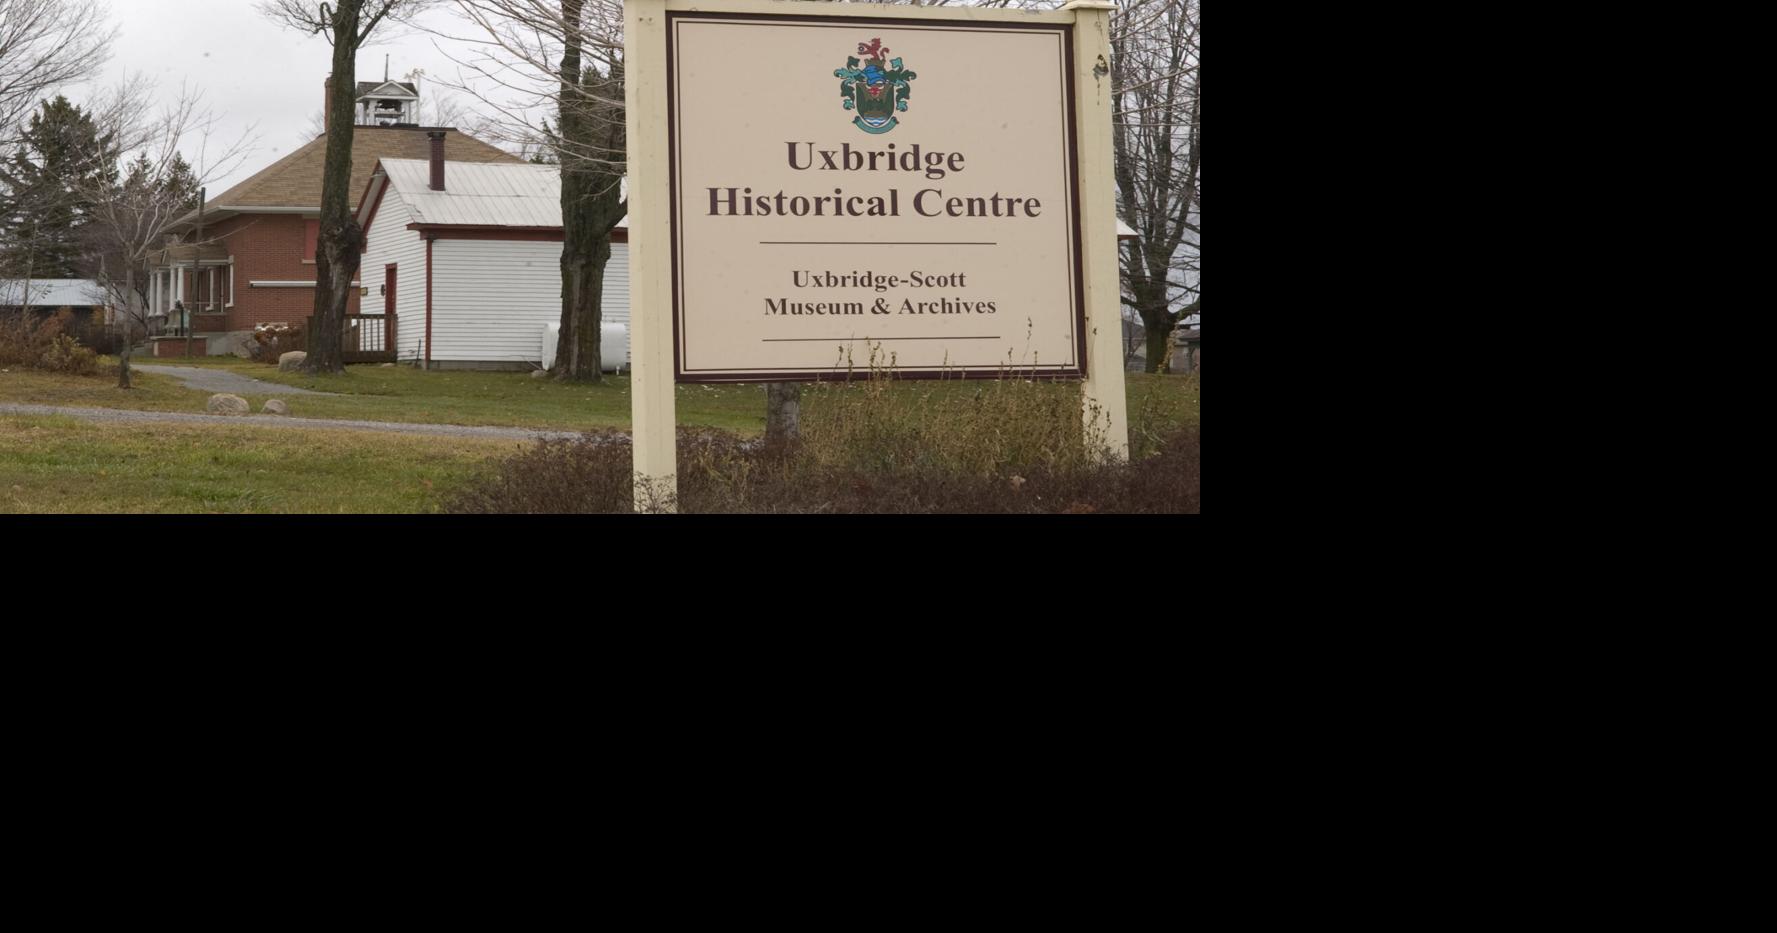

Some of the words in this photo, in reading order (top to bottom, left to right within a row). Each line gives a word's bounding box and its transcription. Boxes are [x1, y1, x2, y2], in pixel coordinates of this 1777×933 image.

[785, 141, 966, 180] Uxbridge
[705, 186, 900, 217] Historical
[912, 188, 1042, 218] Centre
[792, 269, 967, 292] Uxbridge-Scott
[763, 297, 864, 316] Museum
[870, 297, 891, 315] &
[897, 296, 997, 315] Archives
